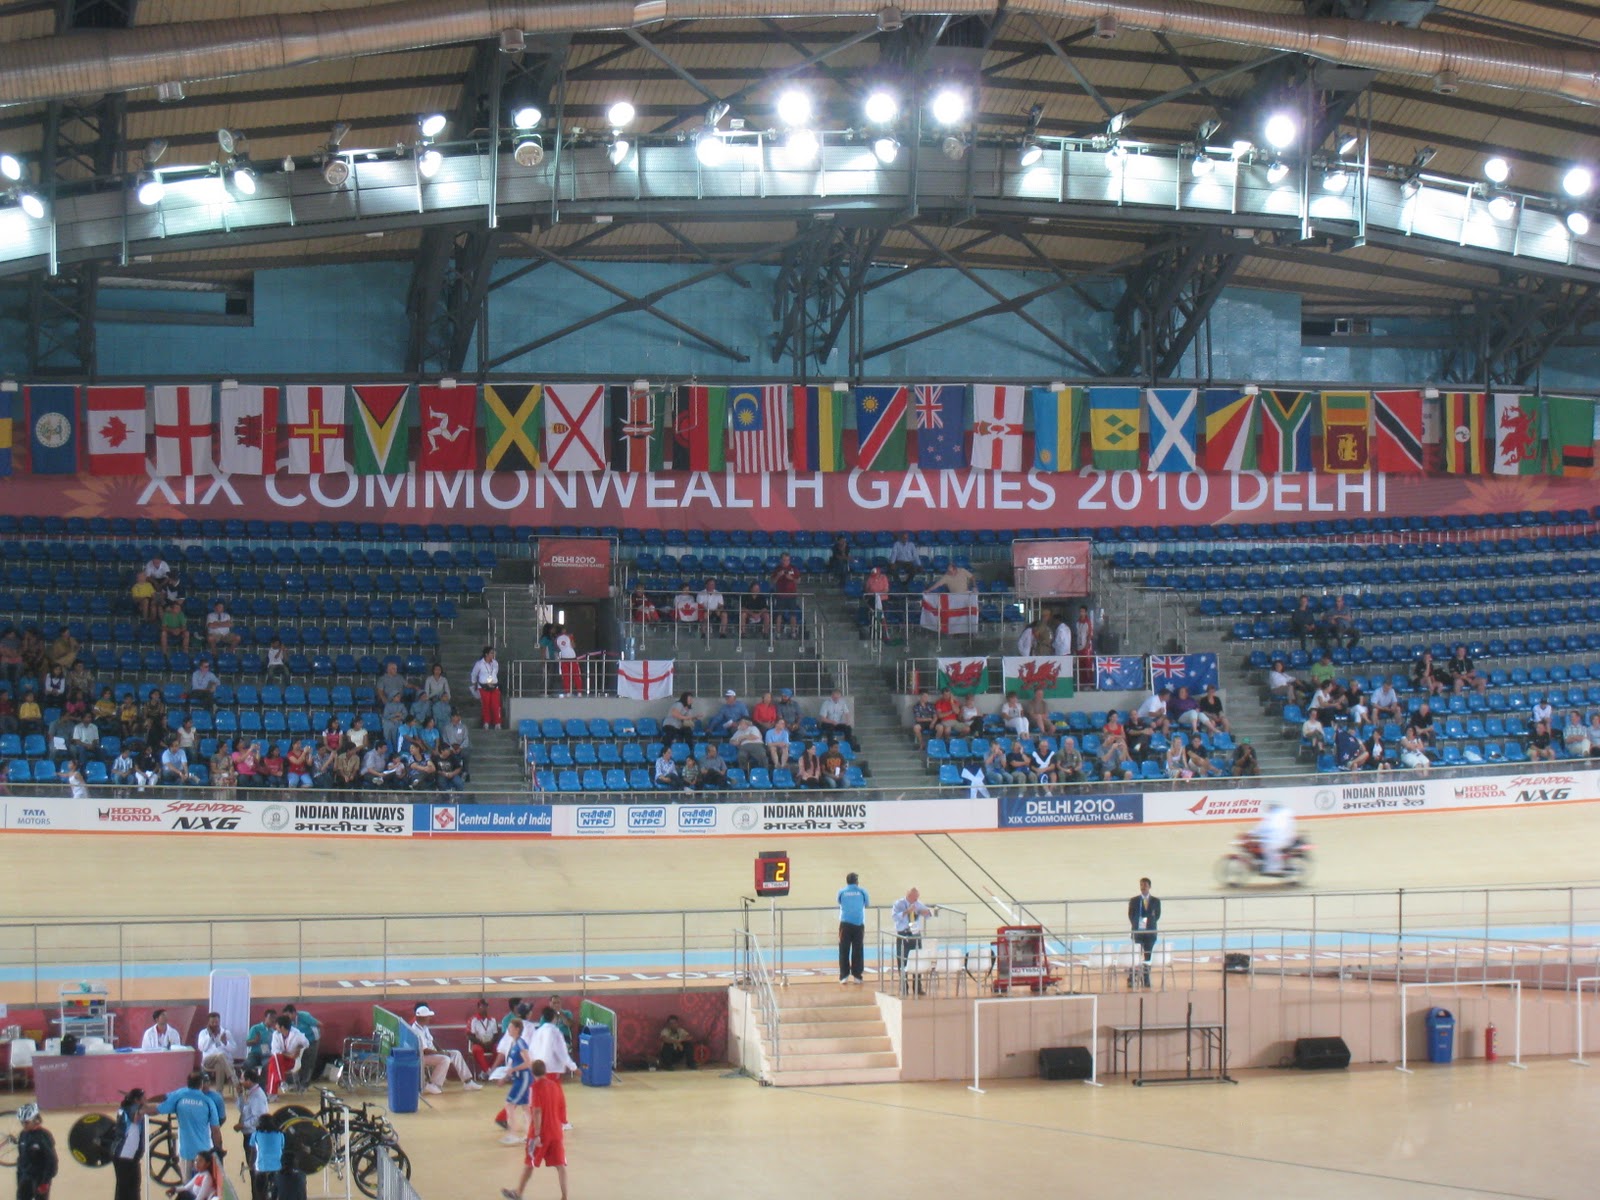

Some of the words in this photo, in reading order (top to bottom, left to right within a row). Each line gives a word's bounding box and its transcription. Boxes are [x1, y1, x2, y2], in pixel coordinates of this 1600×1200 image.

[136, 458, 244, 506] XIX
[265, 458, 824, 509] COMMONWEALTH
[848, 463, 1057, 511] GAMES
[1077, 465, 1209, 511] 2010
[1230, 467, 1387, 512] DELHI
[552, 556, 575, 564] DELHI
[575, 556, 596, 564] 2010
[1027, 557, 1053, 566] DELHI
[1053, 556, 1076, 565] 2010
[1465, 784, 1499, 792] HERO
[1506, 776, 1579, 789] SPLENDOR
[1342, 787, 1376, 800] INDIAN
[1378, 784, 1425, 797] RAILWAYS
[1465, 790, 1506, 799] HONDA
[1515, 788, 1572, 802] NXG
[162, 801, 251, 814] SPLENDOR
[1026, 800, 1071, 815] DELHI
[1074, 799, 1115, 813] 2010
[1343, 798, 1398, 809] भारतीय
[1402, 797, 1425, 806] रेल
[111, 807, 151, 815] HERO
[295, 805, 339, 819] INDIAN
[342, 806, 405, 820] RAILWAYS
[763, 805, 804, 819] INDIAN
[807, 804, 866, 819] RAILWAYS
[17, 817, 51, 826] MOTORS
[110, 814, 162, 823] HONDA
[172, 816, 241, 830] NXG
[459, 812, 491, 826] Central
[493, 813, 516, 826] Bank
[517, 812, 528, 826] of
[529, 812, 552, 826] India
[582, 818, 610, 826] NTPC
[633, 818, 661, 826] NTPC
[1008, 816, 1024, 825] XIX
[1025, 814, 1101, 824] COMMONWEALTH
[1103, 812, 1134, 822] GAMES
[295, 821, 368, 832] भारतीय
[373, 822, 405, 833] रेल
[763, 820, 832, 831] भारतीय
[838, 820, 866, 831] रेल
[775, 862, 787, 882] 2
[182, 1098, 204, 1106] INDIA
